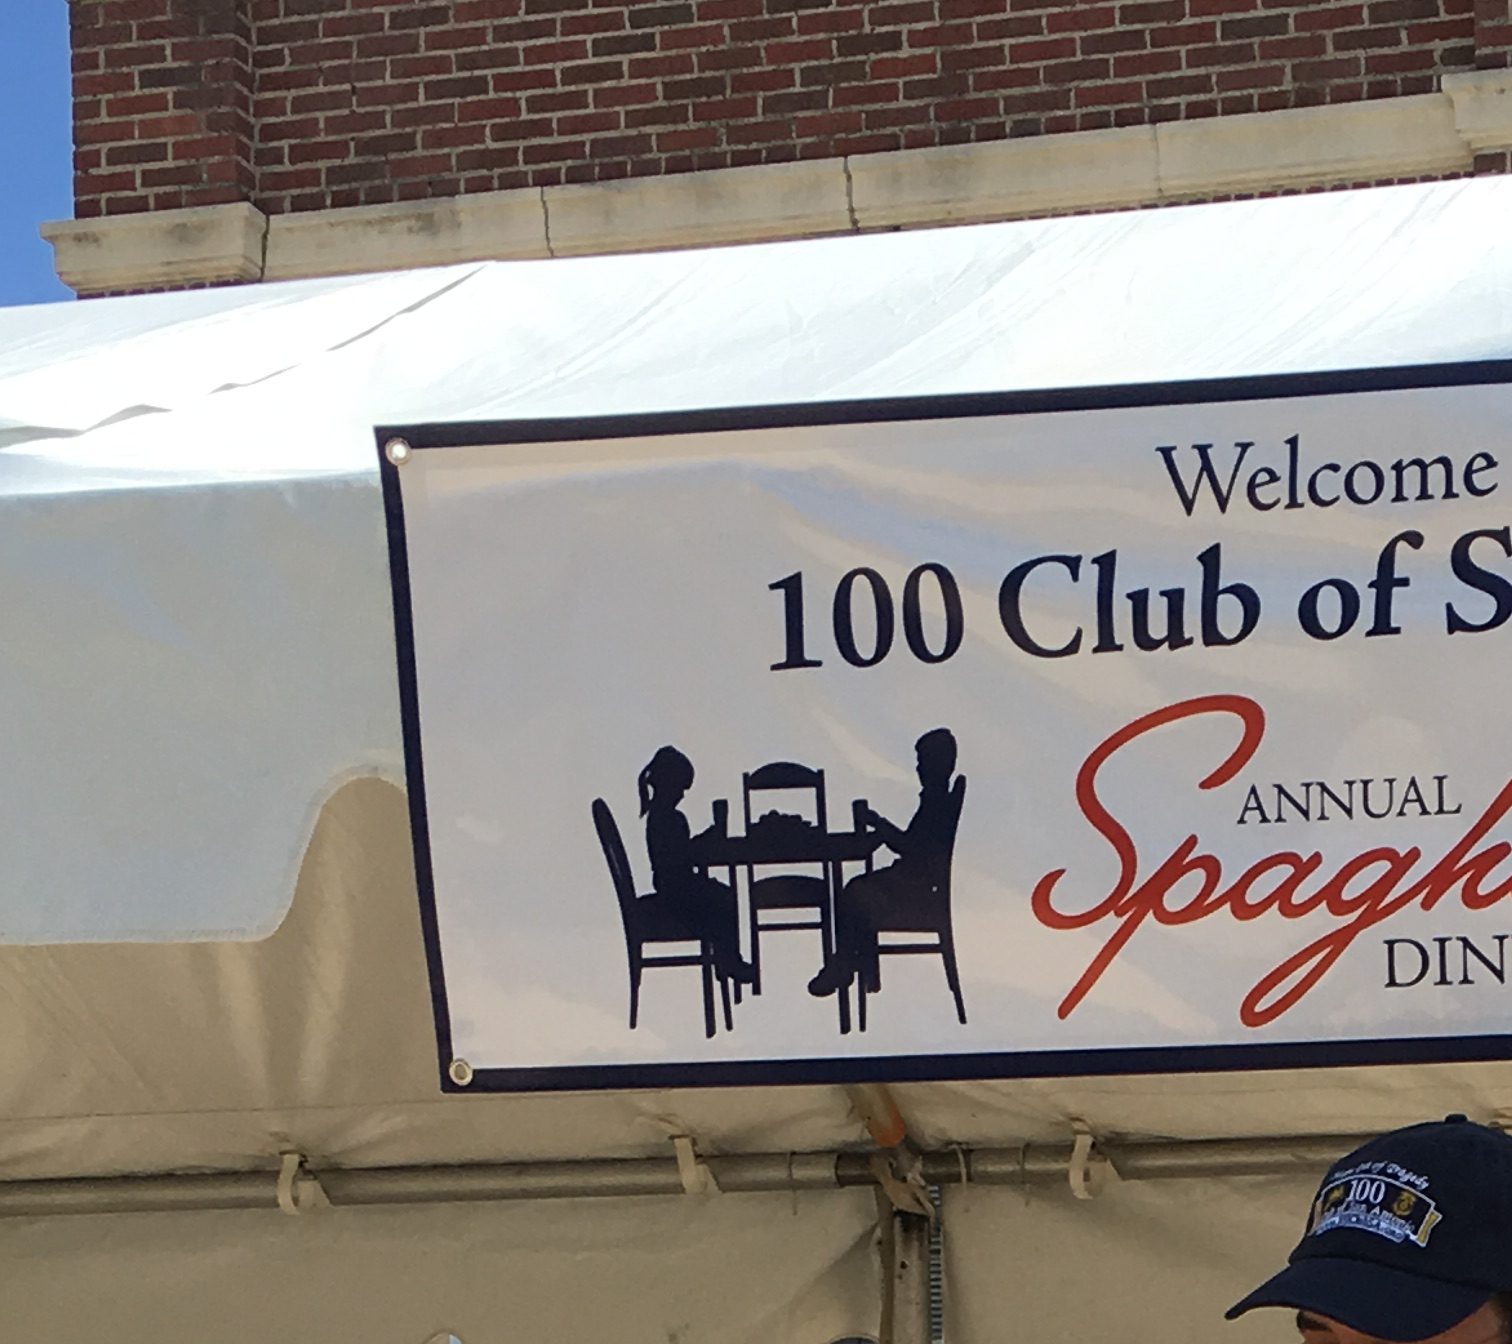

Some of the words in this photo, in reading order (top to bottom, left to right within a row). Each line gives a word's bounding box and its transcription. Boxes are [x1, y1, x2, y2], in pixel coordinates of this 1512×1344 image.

[1155, 434, 1499, 518] Welcome
[767, 561, 966, 673] 100
[997, 544, 1261, 660] Club
[1297, 528, 1426, 641] of
[1235, 772, 1463, 825] ANNUAL
[1346, 1179, 1386, 1204] 100
